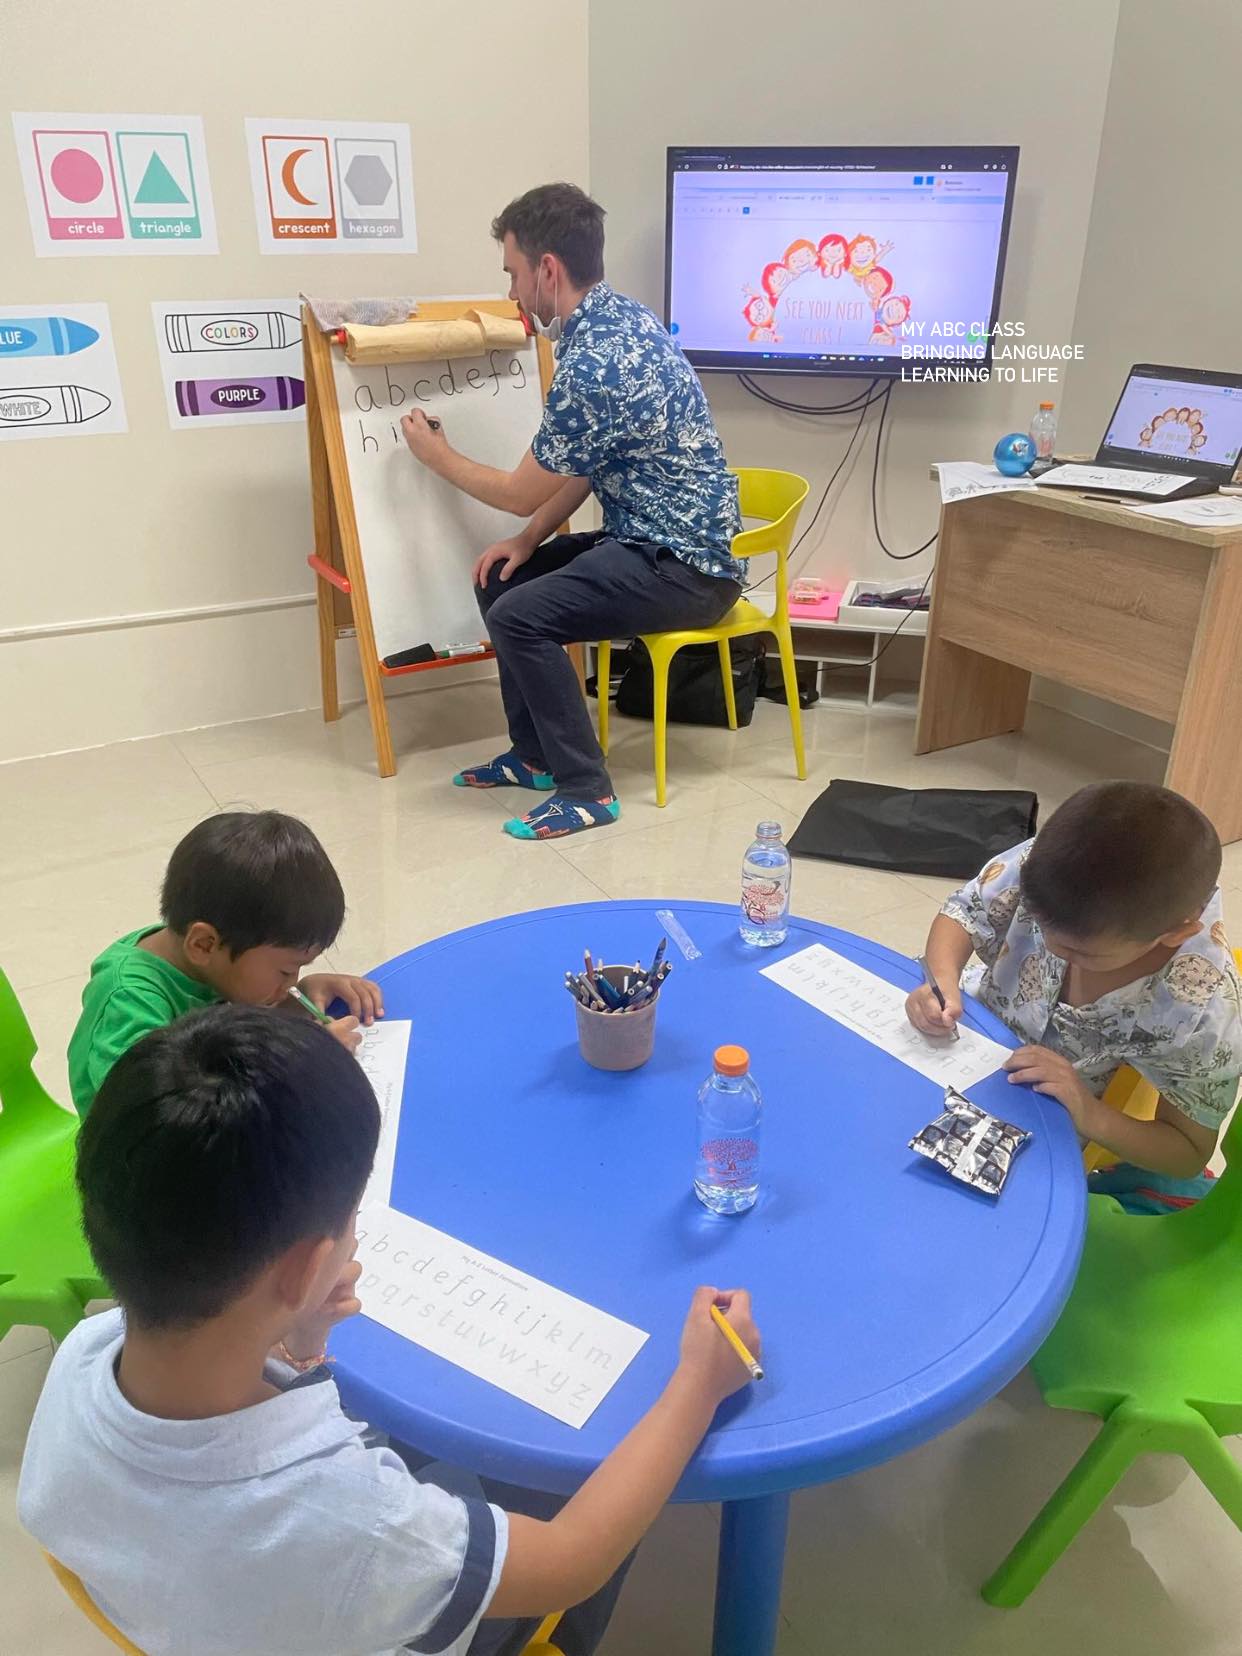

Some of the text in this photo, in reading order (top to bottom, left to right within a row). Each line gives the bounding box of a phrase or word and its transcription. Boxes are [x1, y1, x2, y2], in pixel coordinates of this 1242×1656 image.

[67, 221, 105, 235] circle
[139, 221, 192, 236] triangle
[277, 222, 331, 234] crescent
[348, 221, 397, 236] hexagon
[808, 300, 832, 321] YOU
[835, 301, 865, 321] NEXT
[205, 325, 256, 340] COLORS
[218, 388, 261, 403] PURPLE
[0, 401, 41, 417] WHITE
